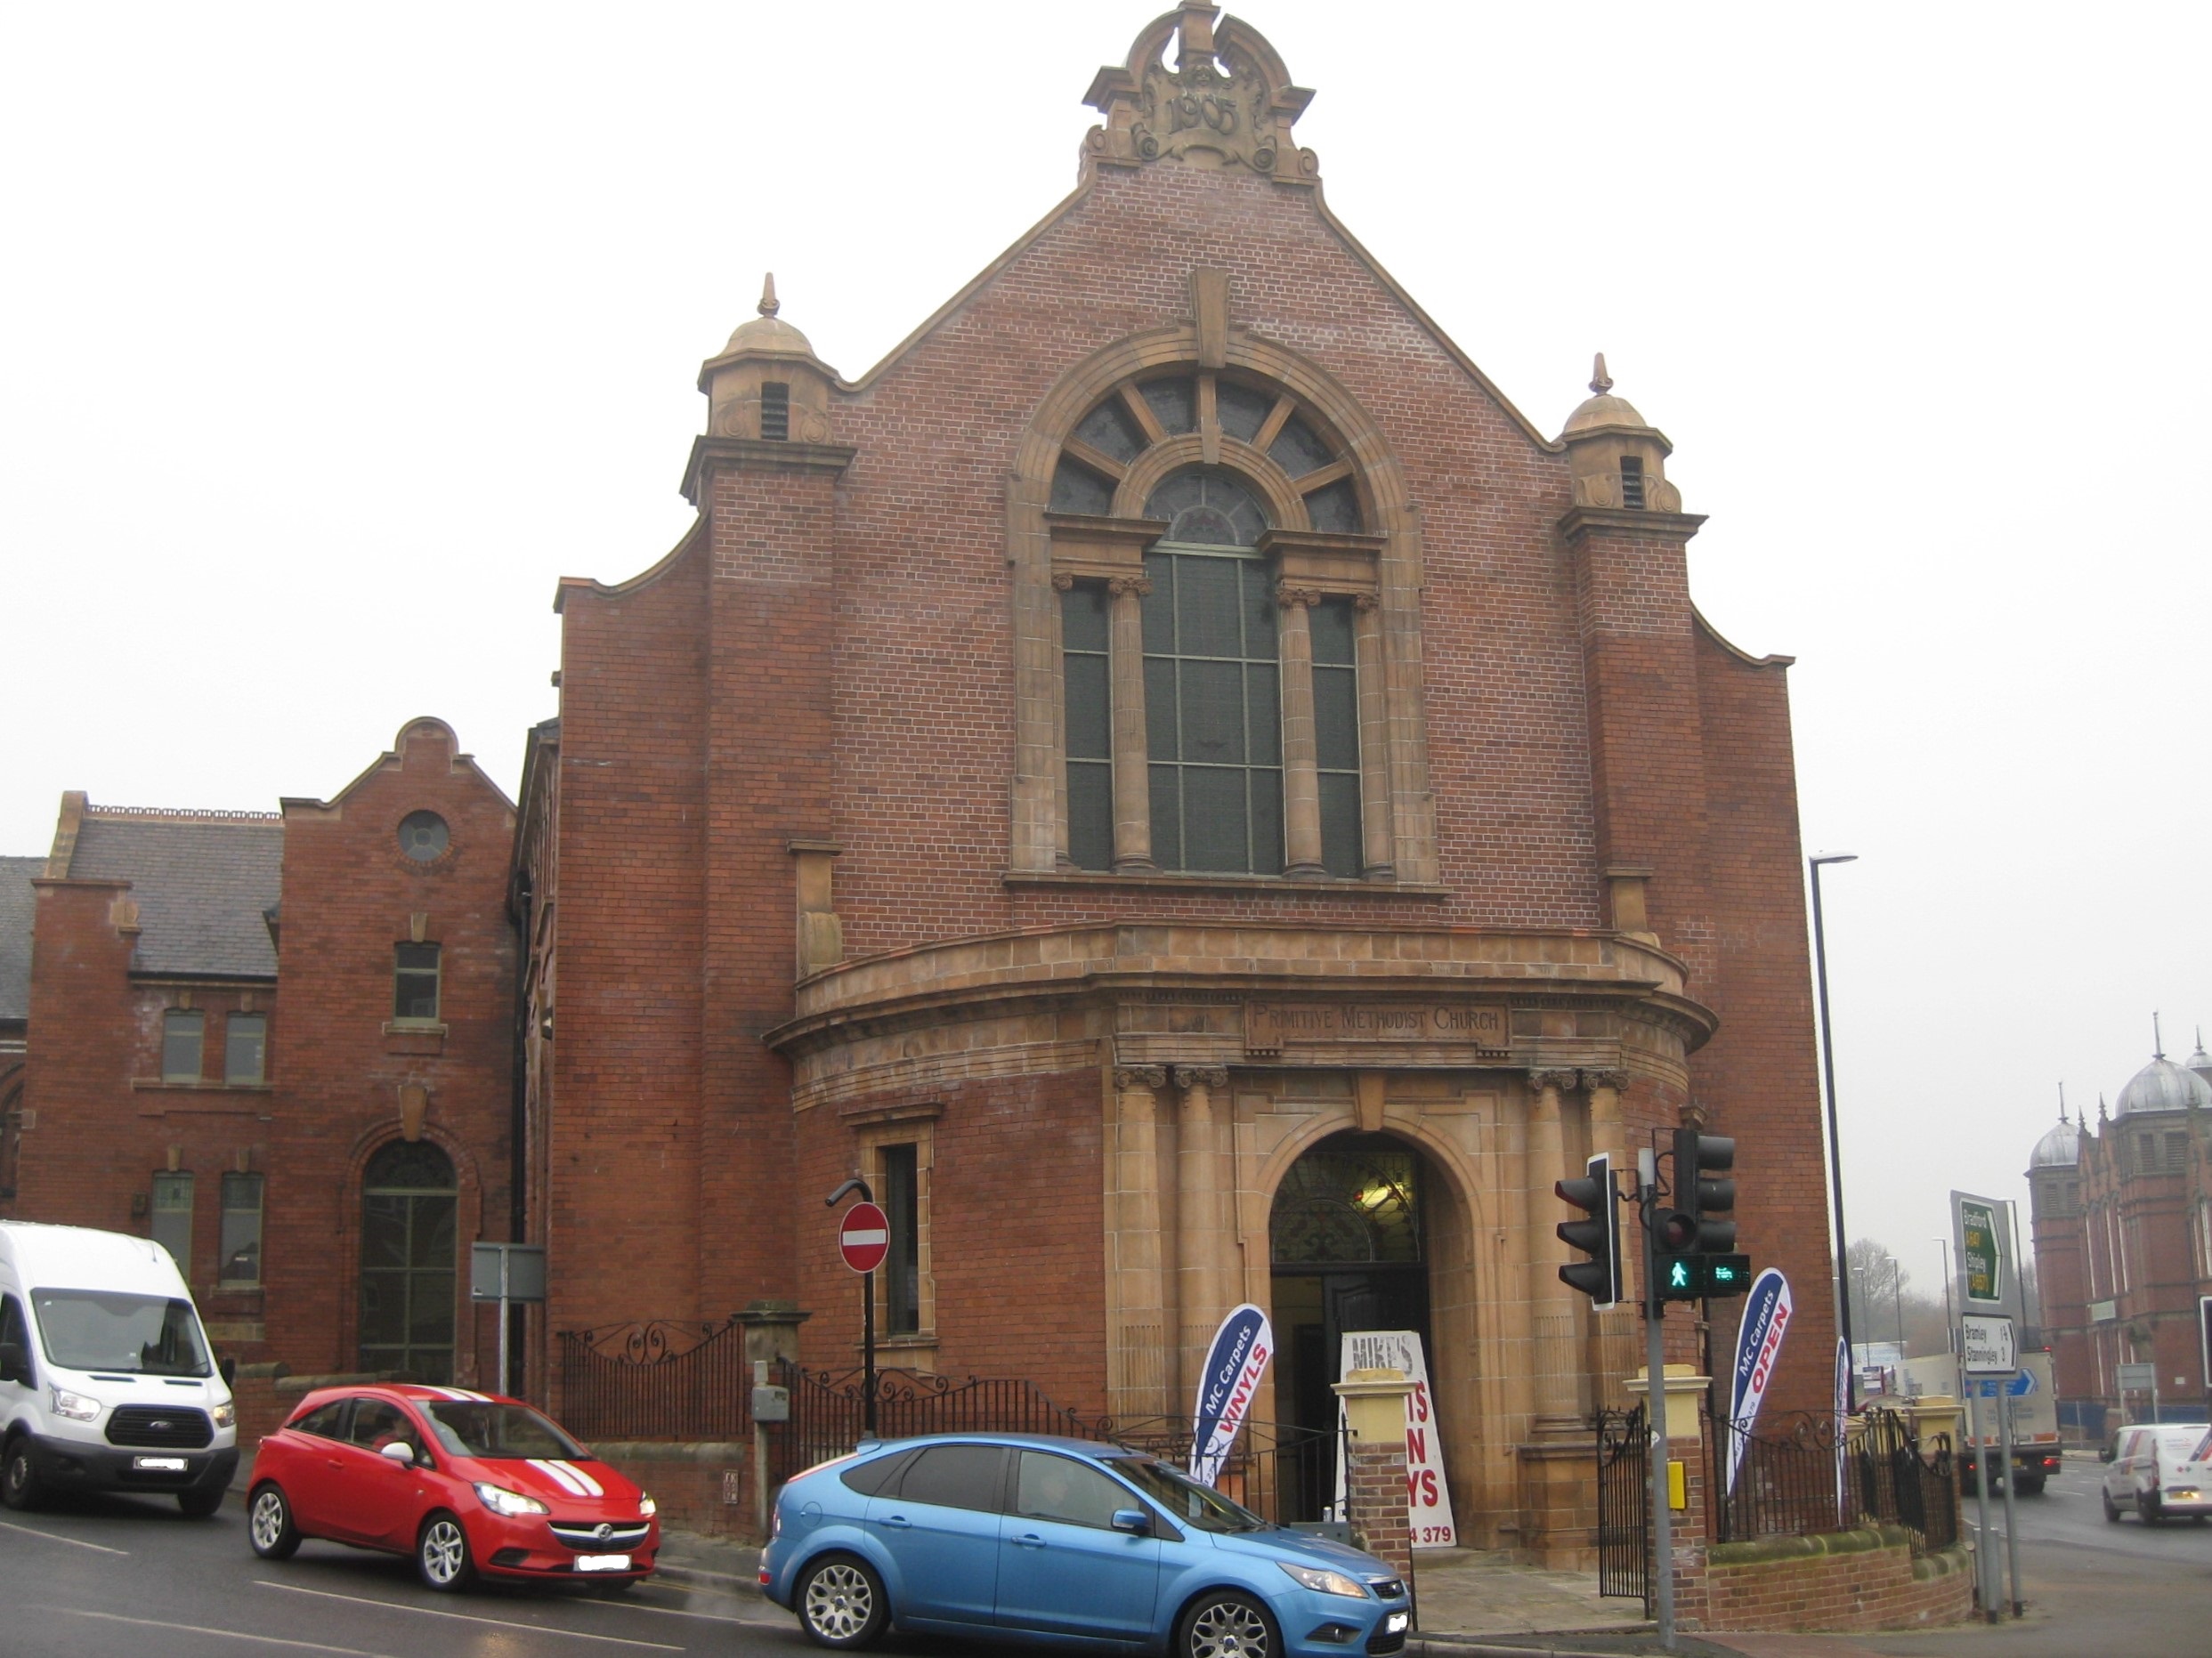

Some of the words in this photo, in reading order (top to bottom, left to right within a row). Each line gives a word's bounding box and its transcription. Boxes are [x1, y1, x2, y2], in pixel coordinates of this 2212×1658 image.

[1166, 93, 1240, 135] 1905
[1252, 1004, 1333, 1028] PRIMITIVE
[1341, 1006, 1426, 1030] METHODIST
[1433, 1007, 1499, 1031] CHURCH
[1205, 1384, 1224, 1415] MC
[1219, 1325, 1252, 1386] Carpets
[1739, 1347, 1754, 1377] MC
[1750, 1290, 1774, 1347] Carpets
[1753, 1302, 1788, 1393] OPEN
[1219, 1343, 1268, 1433] VINYLS
[1422, 1526, 1452, 1543] 379
